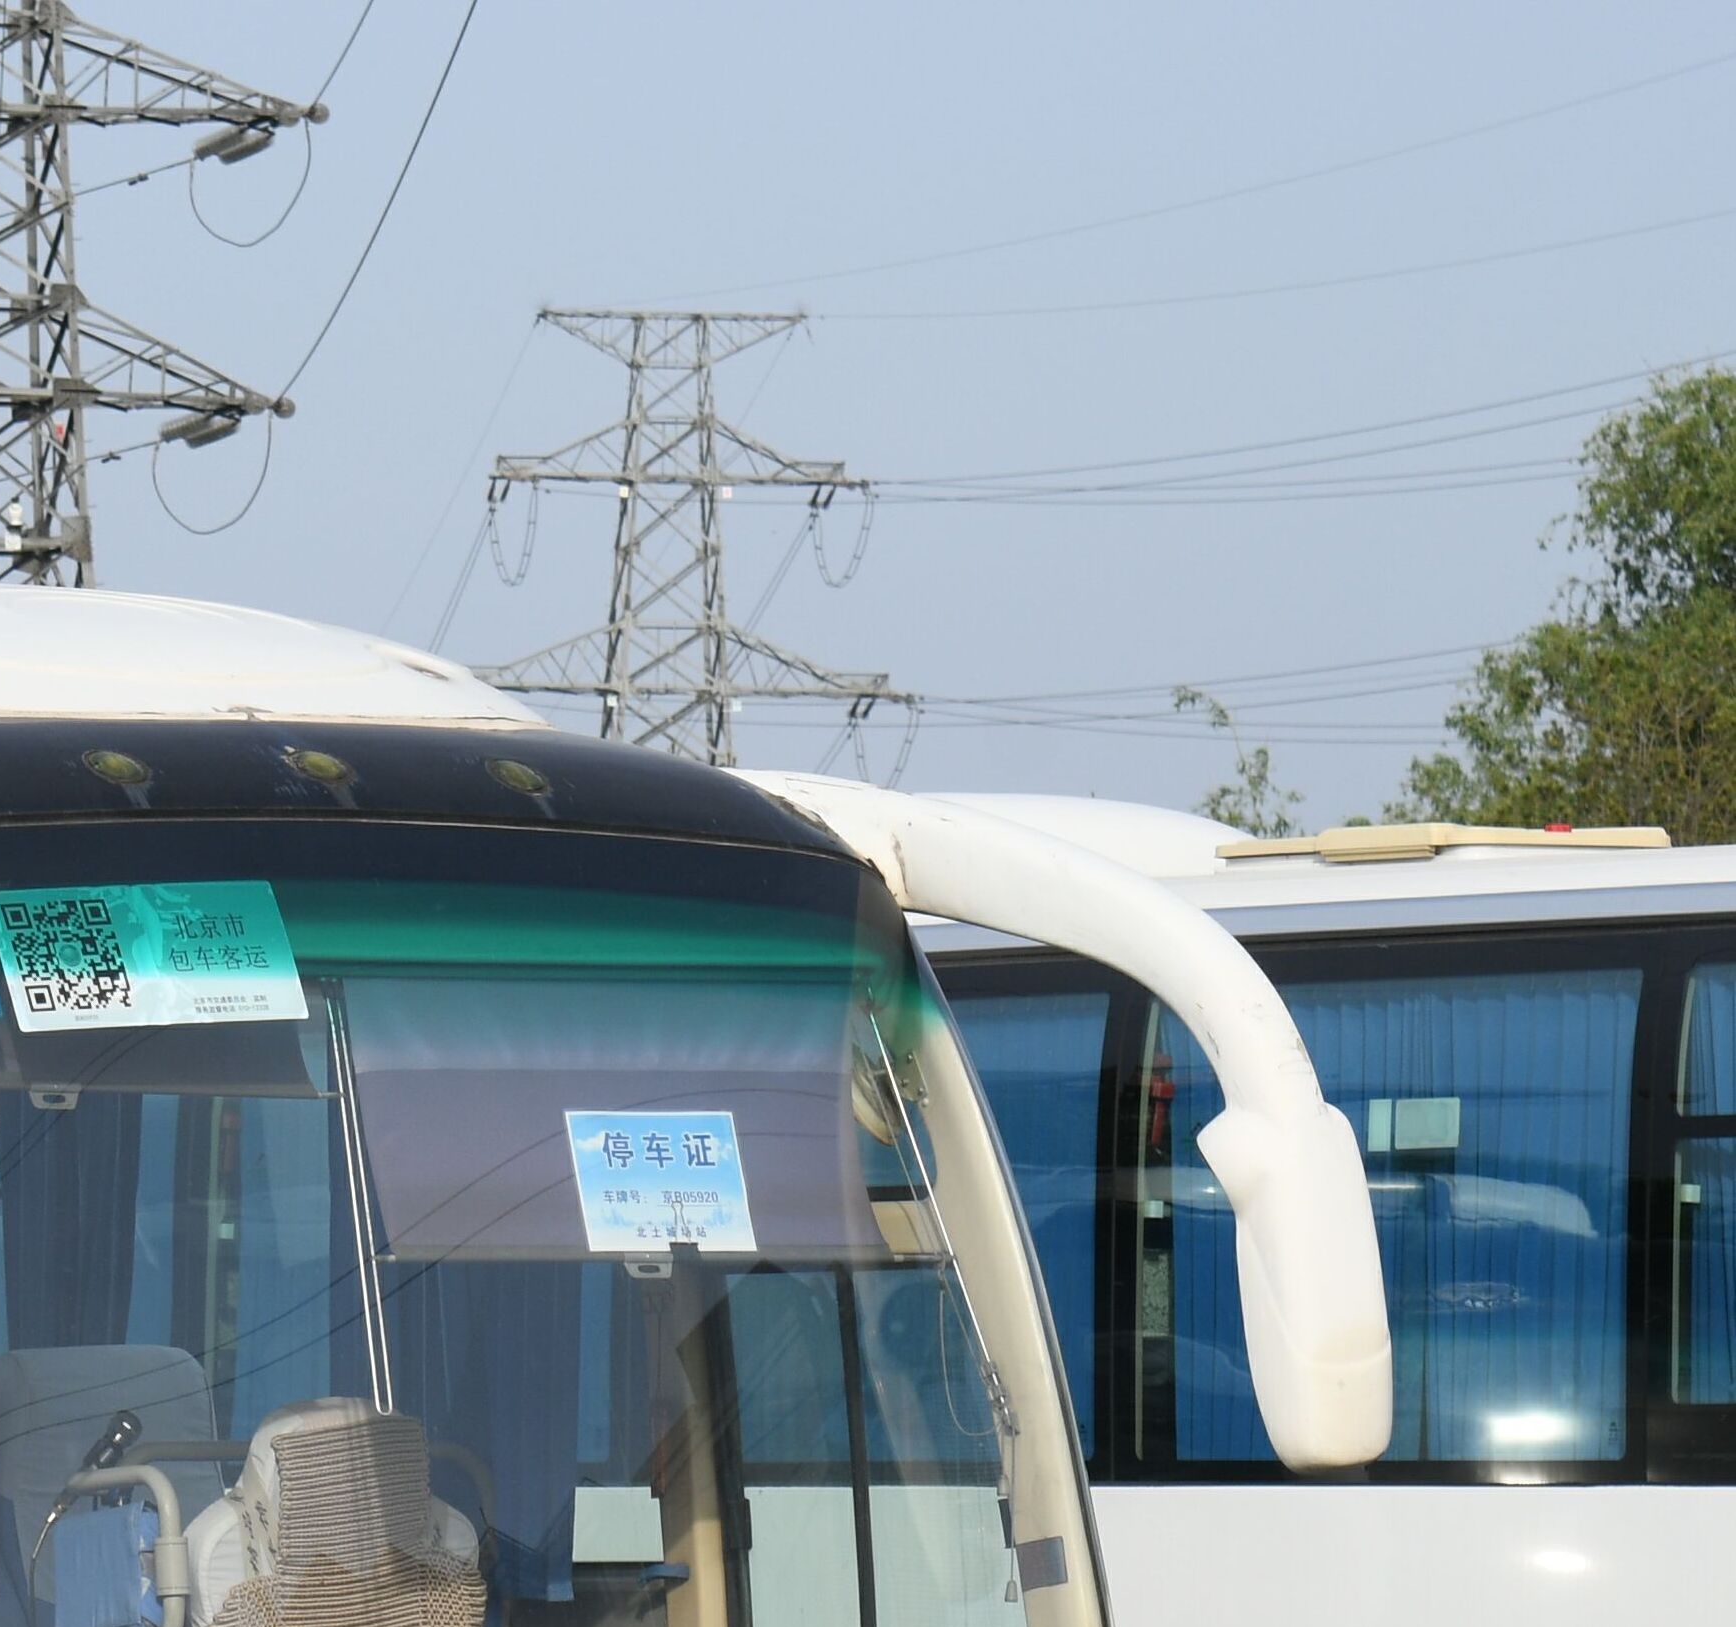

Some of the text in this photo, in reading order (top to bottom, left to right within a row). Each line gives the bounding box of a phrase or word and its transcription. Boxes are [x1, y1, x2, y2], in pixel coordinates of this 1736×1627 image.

[173, 913, 245, 939] 北京市
[169, 945, 270, 971] 包车客运
[602, 1132, 716, 1168] 停车证
[661, 1191, 719, 1204] 京B05920
